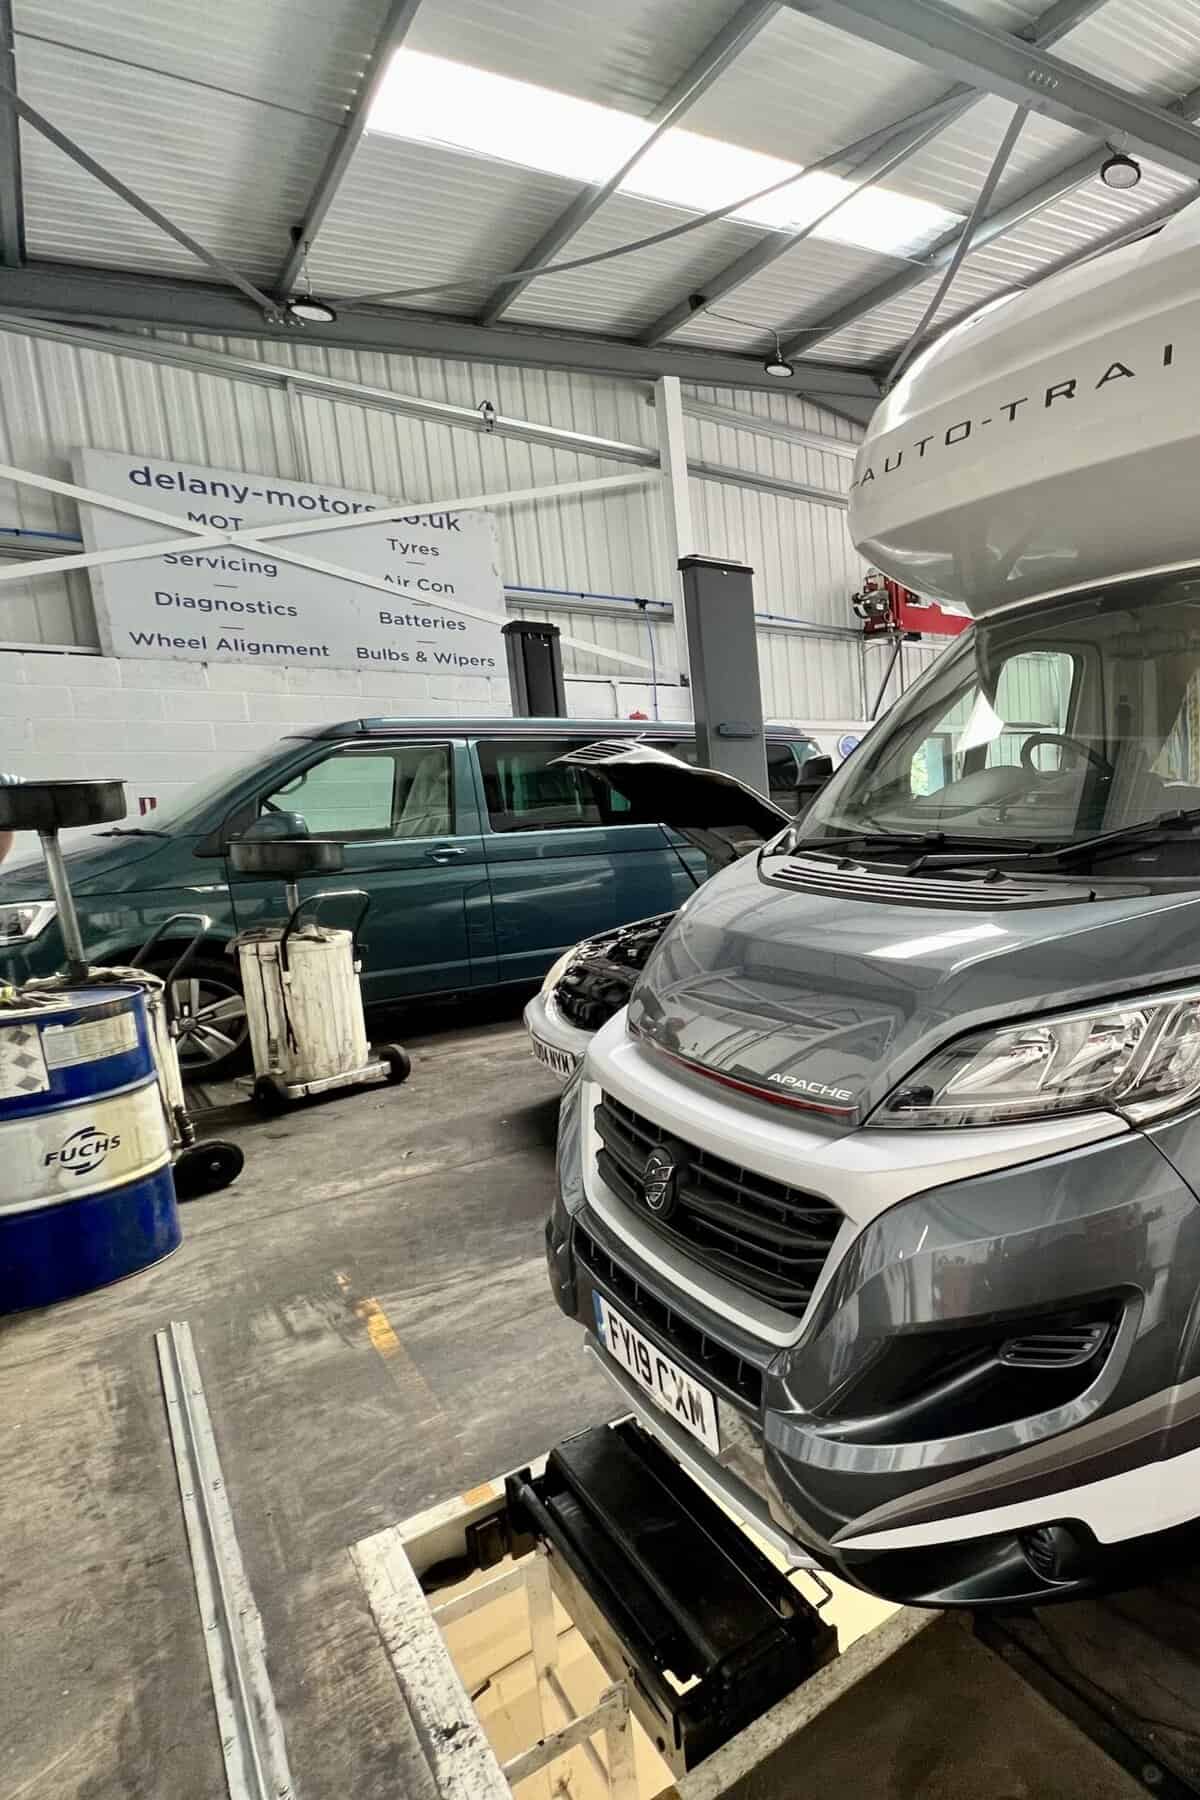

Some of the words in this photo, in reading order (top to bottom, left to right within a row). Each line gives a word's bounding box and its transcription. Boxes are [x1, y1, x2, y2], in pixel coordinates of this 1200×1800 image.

[187, 511, 243, 531] MOT
[386, 538, 440, 556] Tyres
[163, 553, 278, 577] Servicing
[417, 578, 456, 594] Con
[154, 591, 298, 617] Diagnostics
[379, 611, 467, 631] Batteries
[128, 631, 207, 650] Wheel
[216, 638, 331, 657] Alignment
[356, 647, 410, 662] Bulbs
[415, 651, 428, 663] &
[433, 652, 496, 668] Wipers
[767, 1072, 852, 1101] APACHE
[44, 1134, 121, 1168] FUCHS
[607, 1311, 653, 1386] FY19
